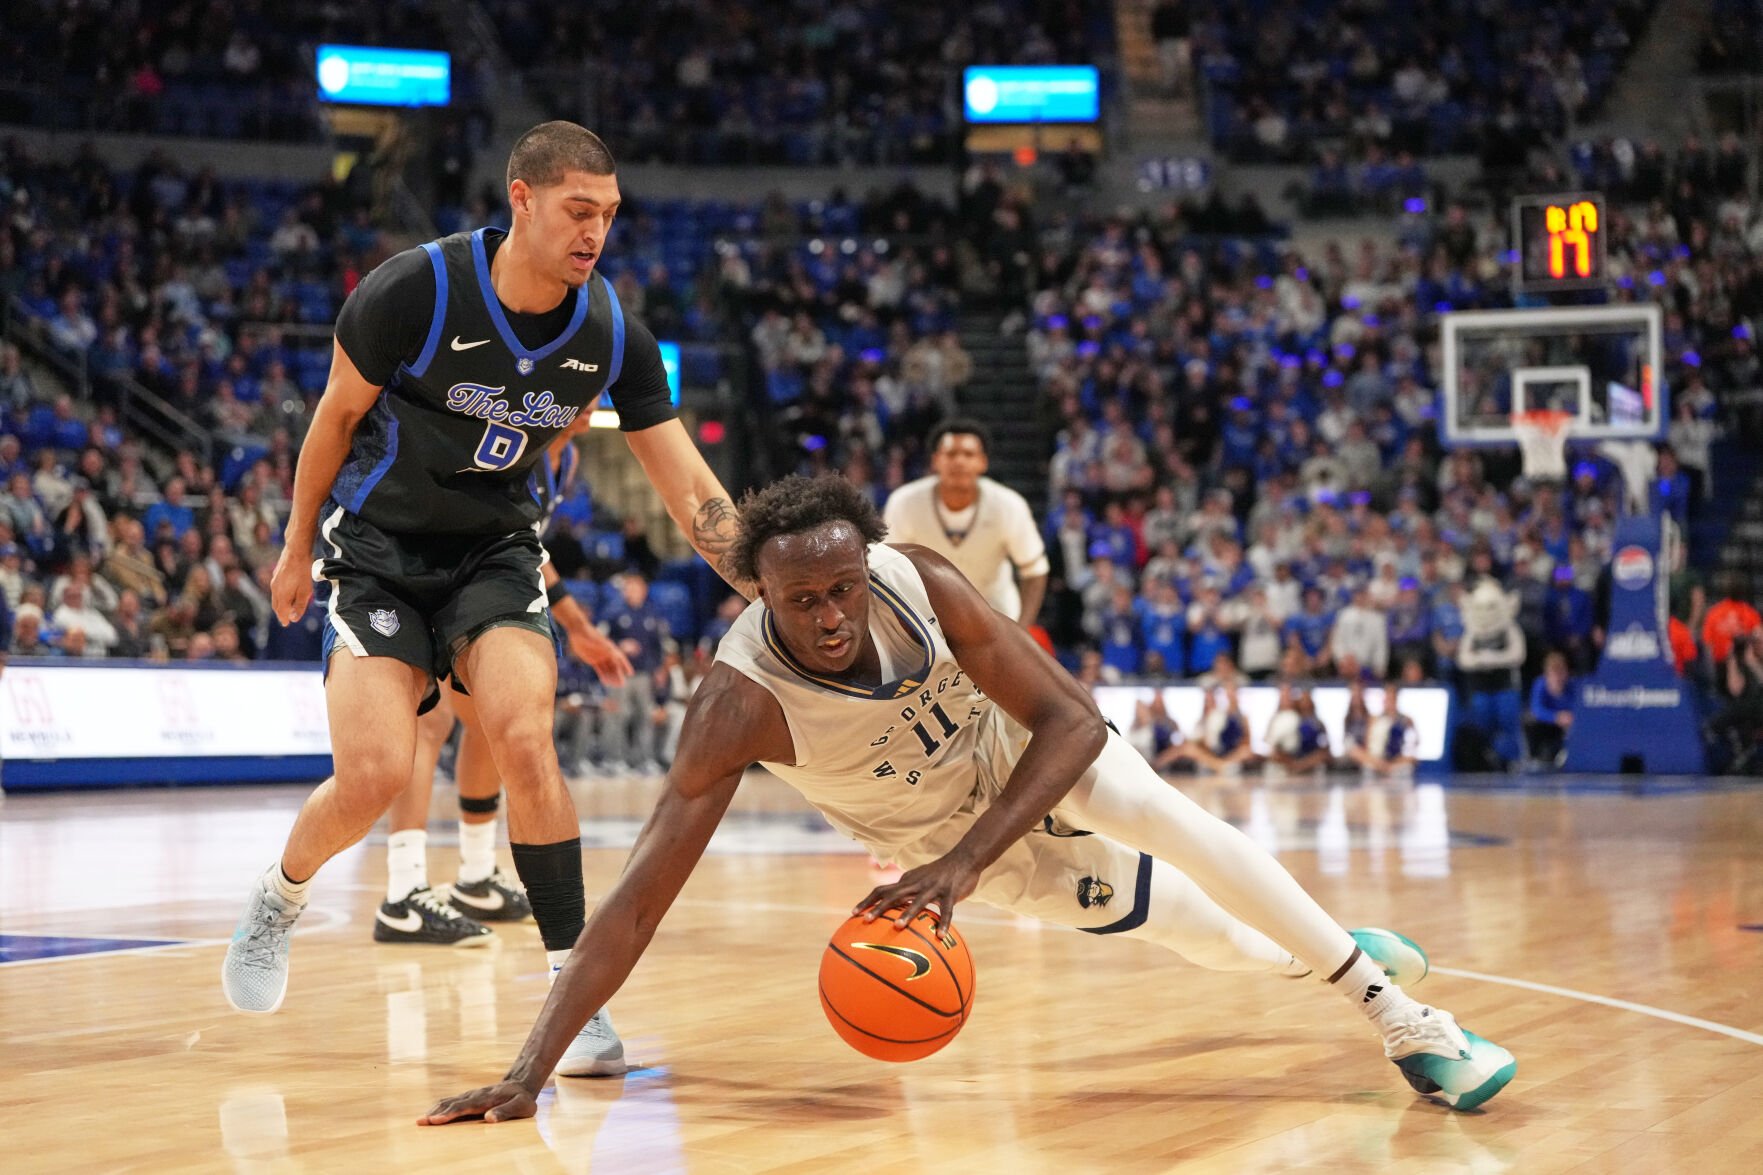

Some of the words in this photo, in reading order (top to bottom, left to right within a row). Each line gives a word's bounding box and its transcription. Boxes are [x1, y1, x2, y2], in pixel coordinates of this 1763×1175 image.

[560, 358, 599, 373] A10
[446, 382, 509, 422] The
[509, 390, 579, 428] Lou
[910, 701, 960, 758] 11
